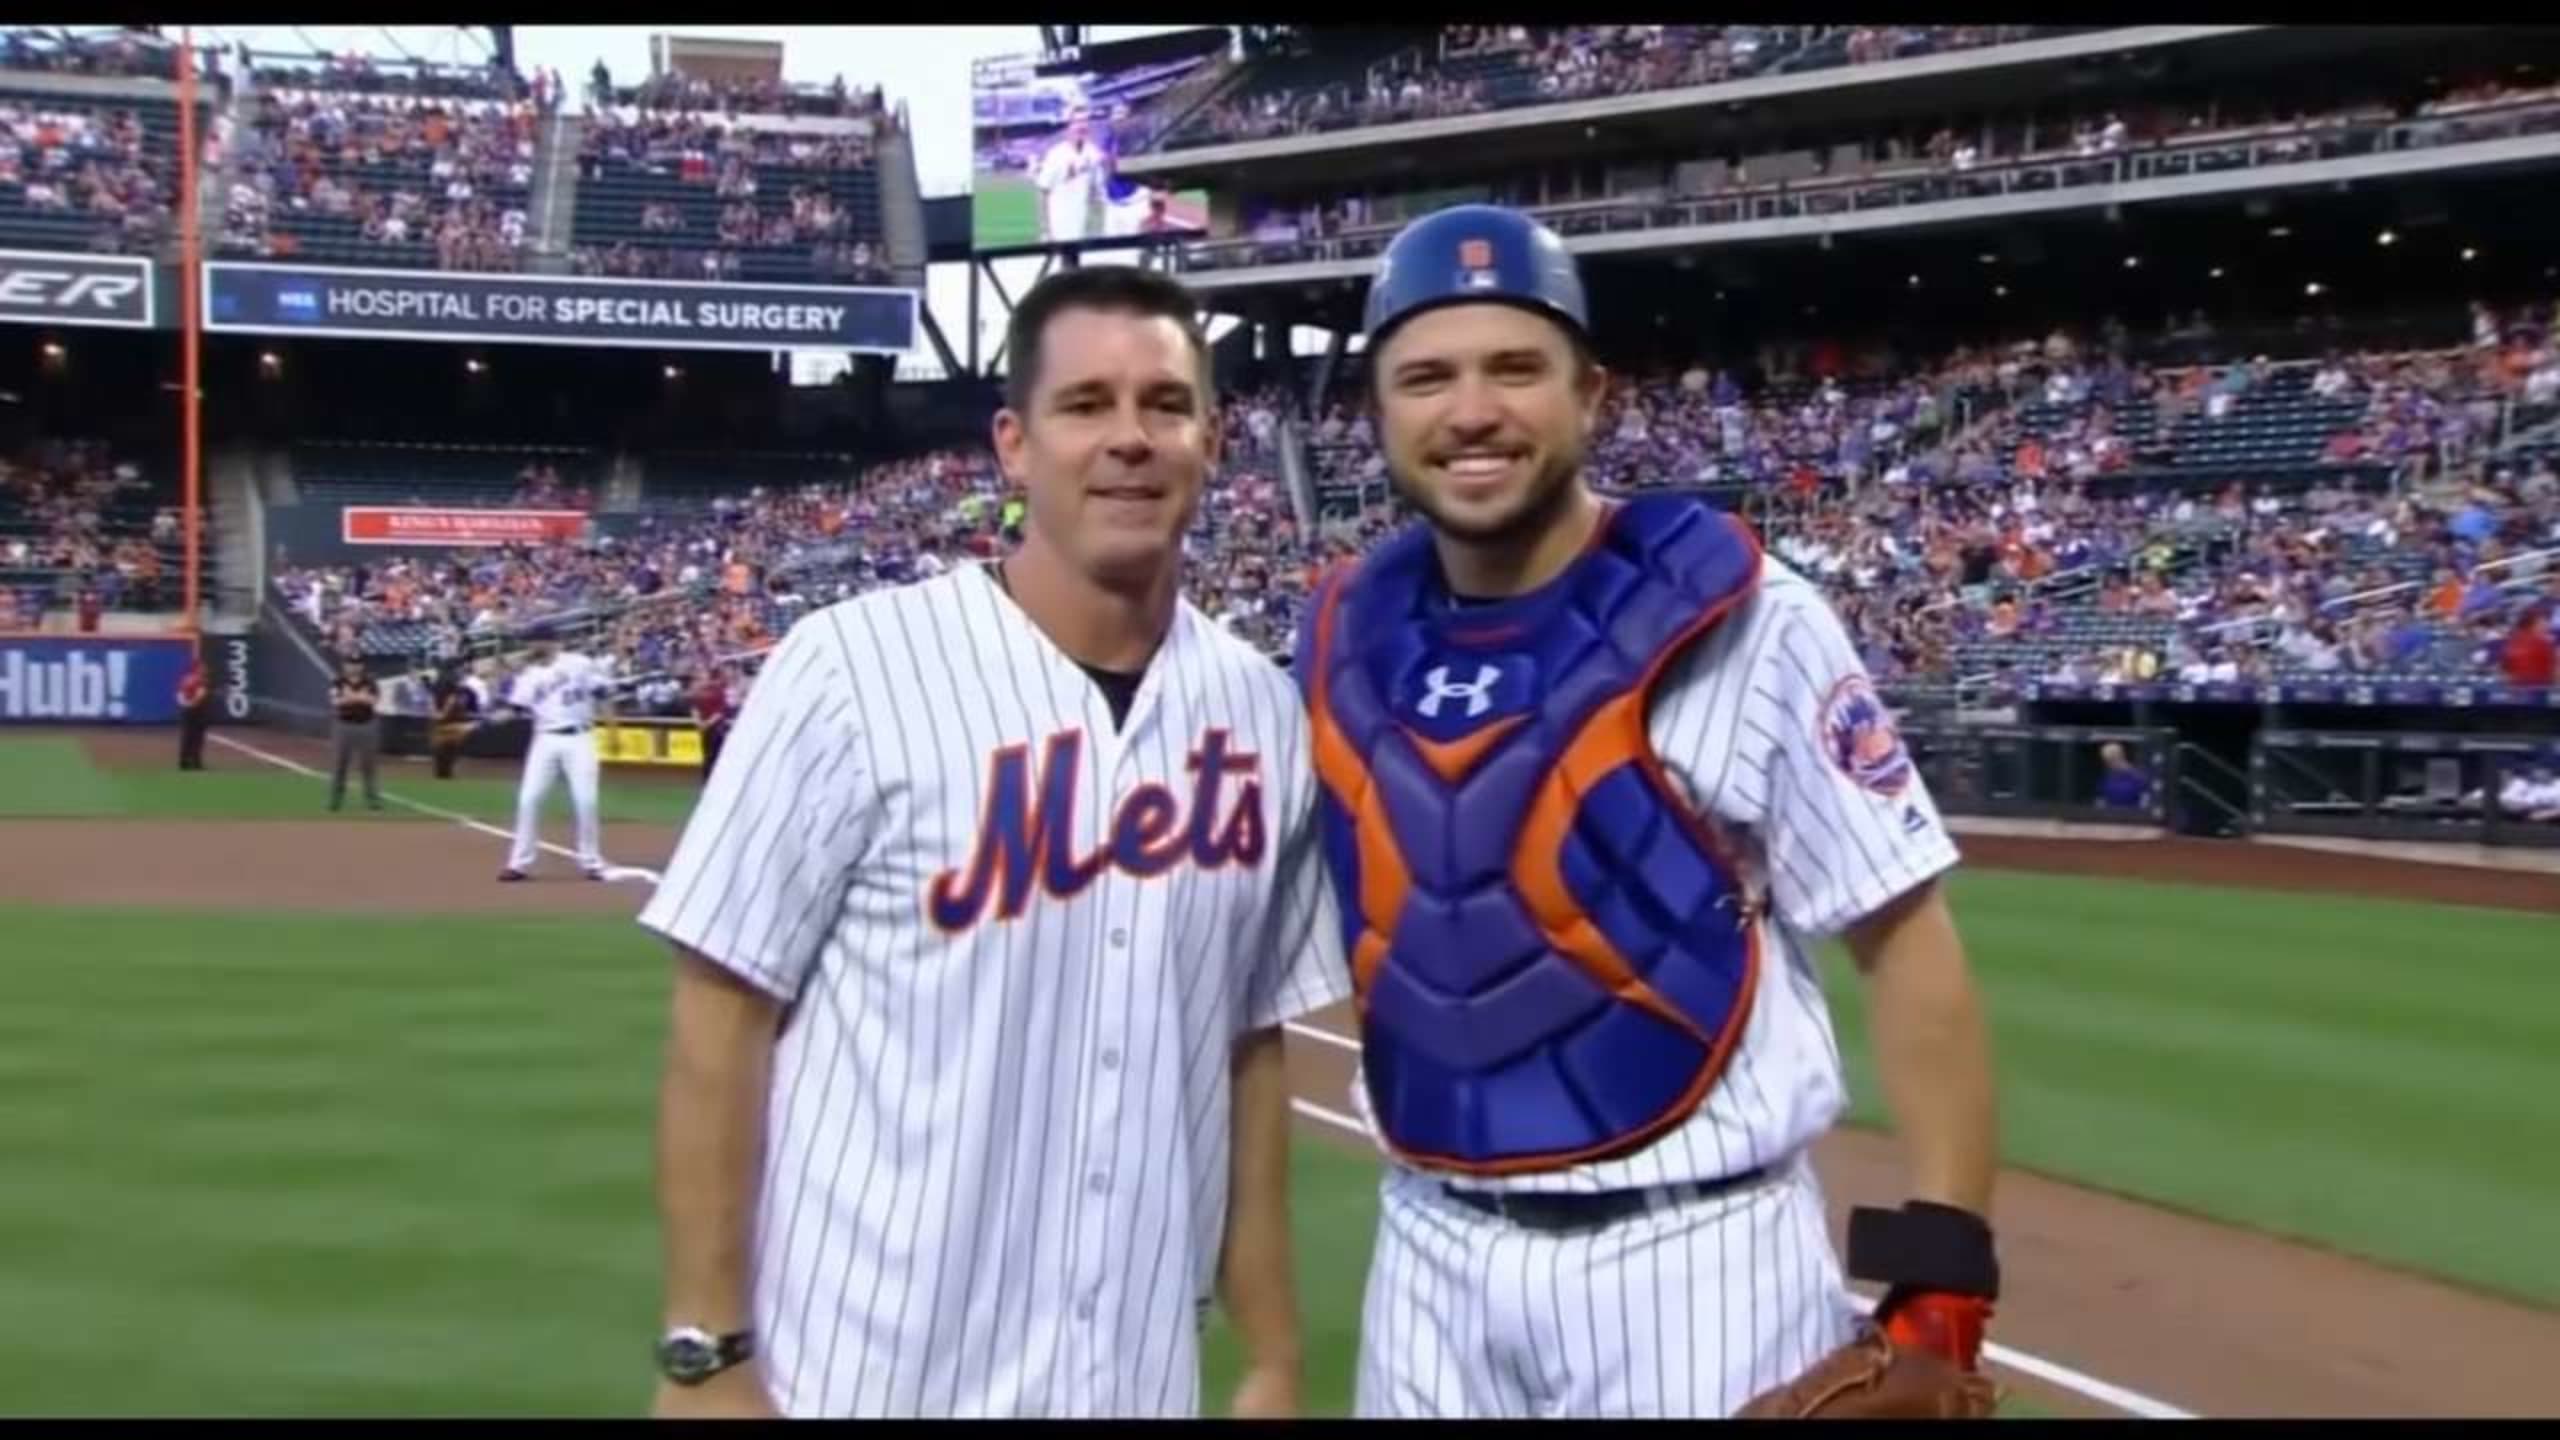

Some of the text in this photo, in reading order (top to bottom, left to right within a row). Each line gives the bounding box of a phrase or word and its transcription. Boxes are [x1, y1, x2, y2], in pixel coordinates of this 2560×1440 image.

[328, 289, 479, 319] HOSPITAL
[486, 294, 546, 321] FOR
[554, 297, 691, 326] SPECIAL
[699, 301, 845, 331] SURGERY
[928, 727, 1266, 937] Mets
